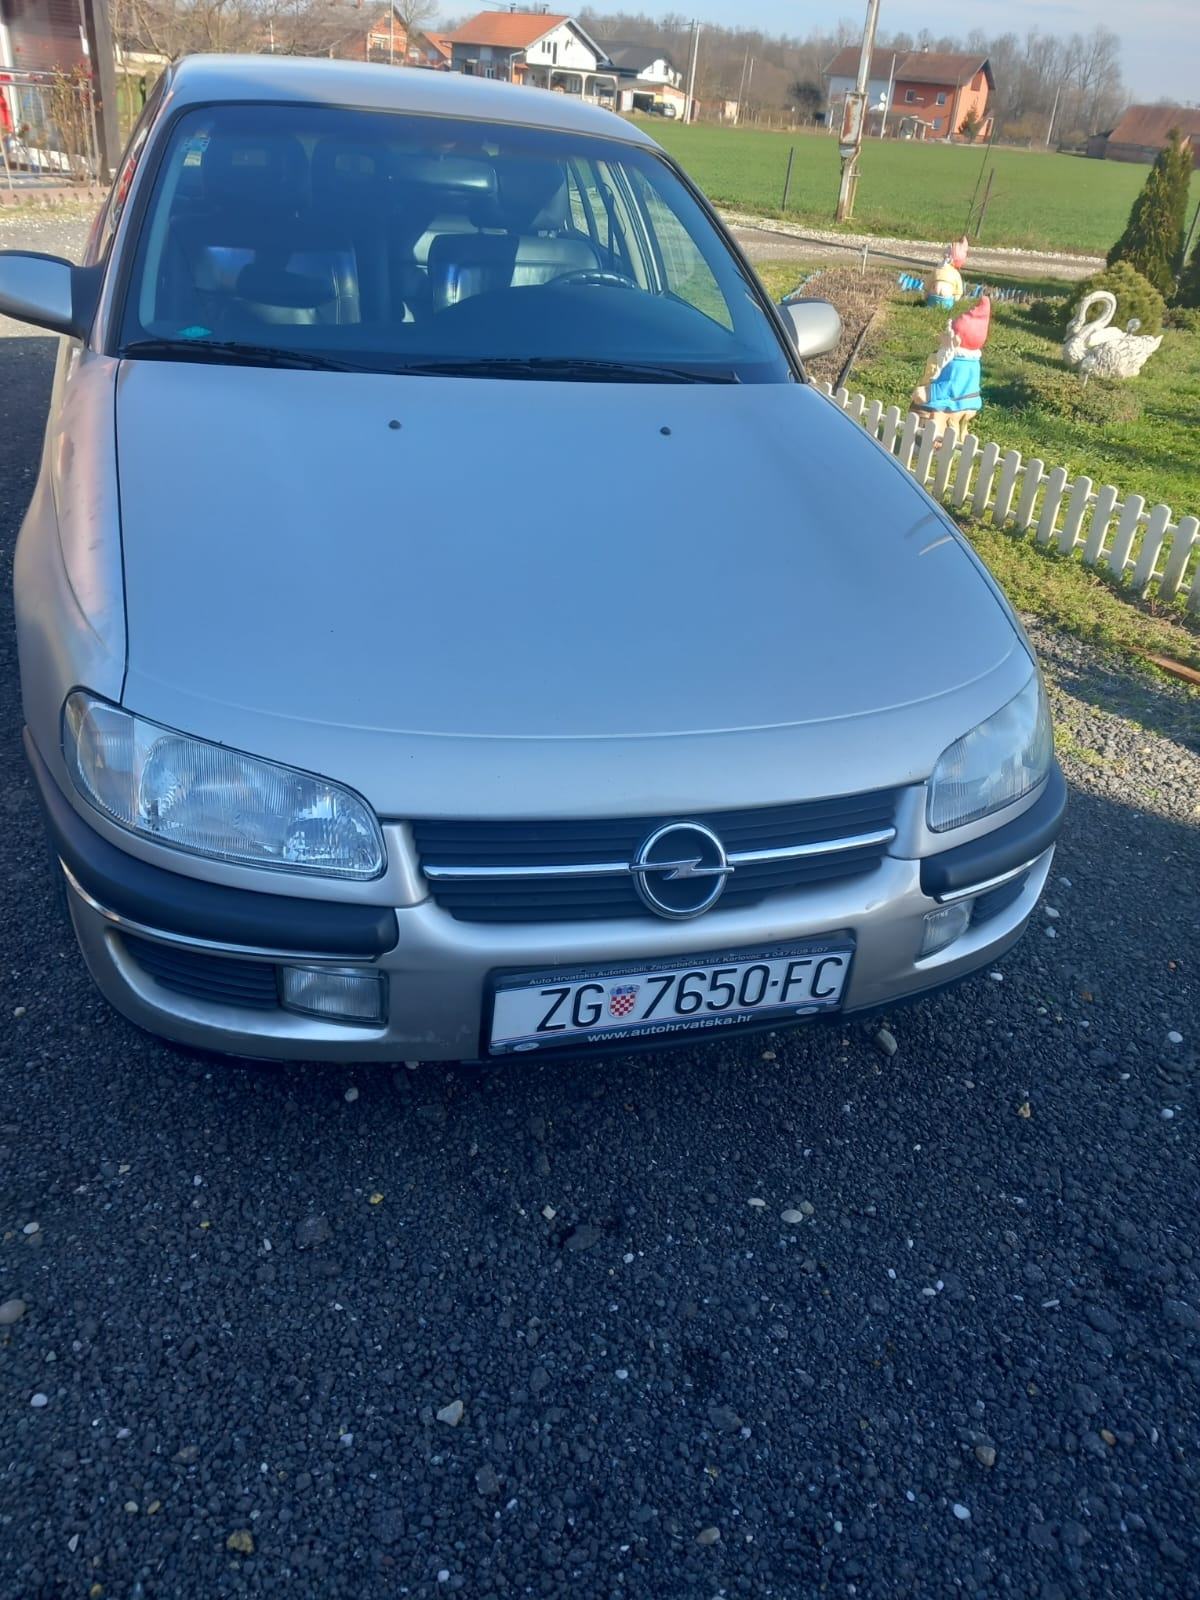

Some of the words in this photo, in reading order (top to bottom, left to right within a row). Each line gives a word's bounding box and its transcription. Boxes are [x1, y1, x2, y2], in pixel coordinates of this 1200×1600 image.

[529, 977, 551, 985] Auto
[537, 983, 604, 1032] ZG
[587, 1013, 754, 1043] www.autohrvatska.hr
